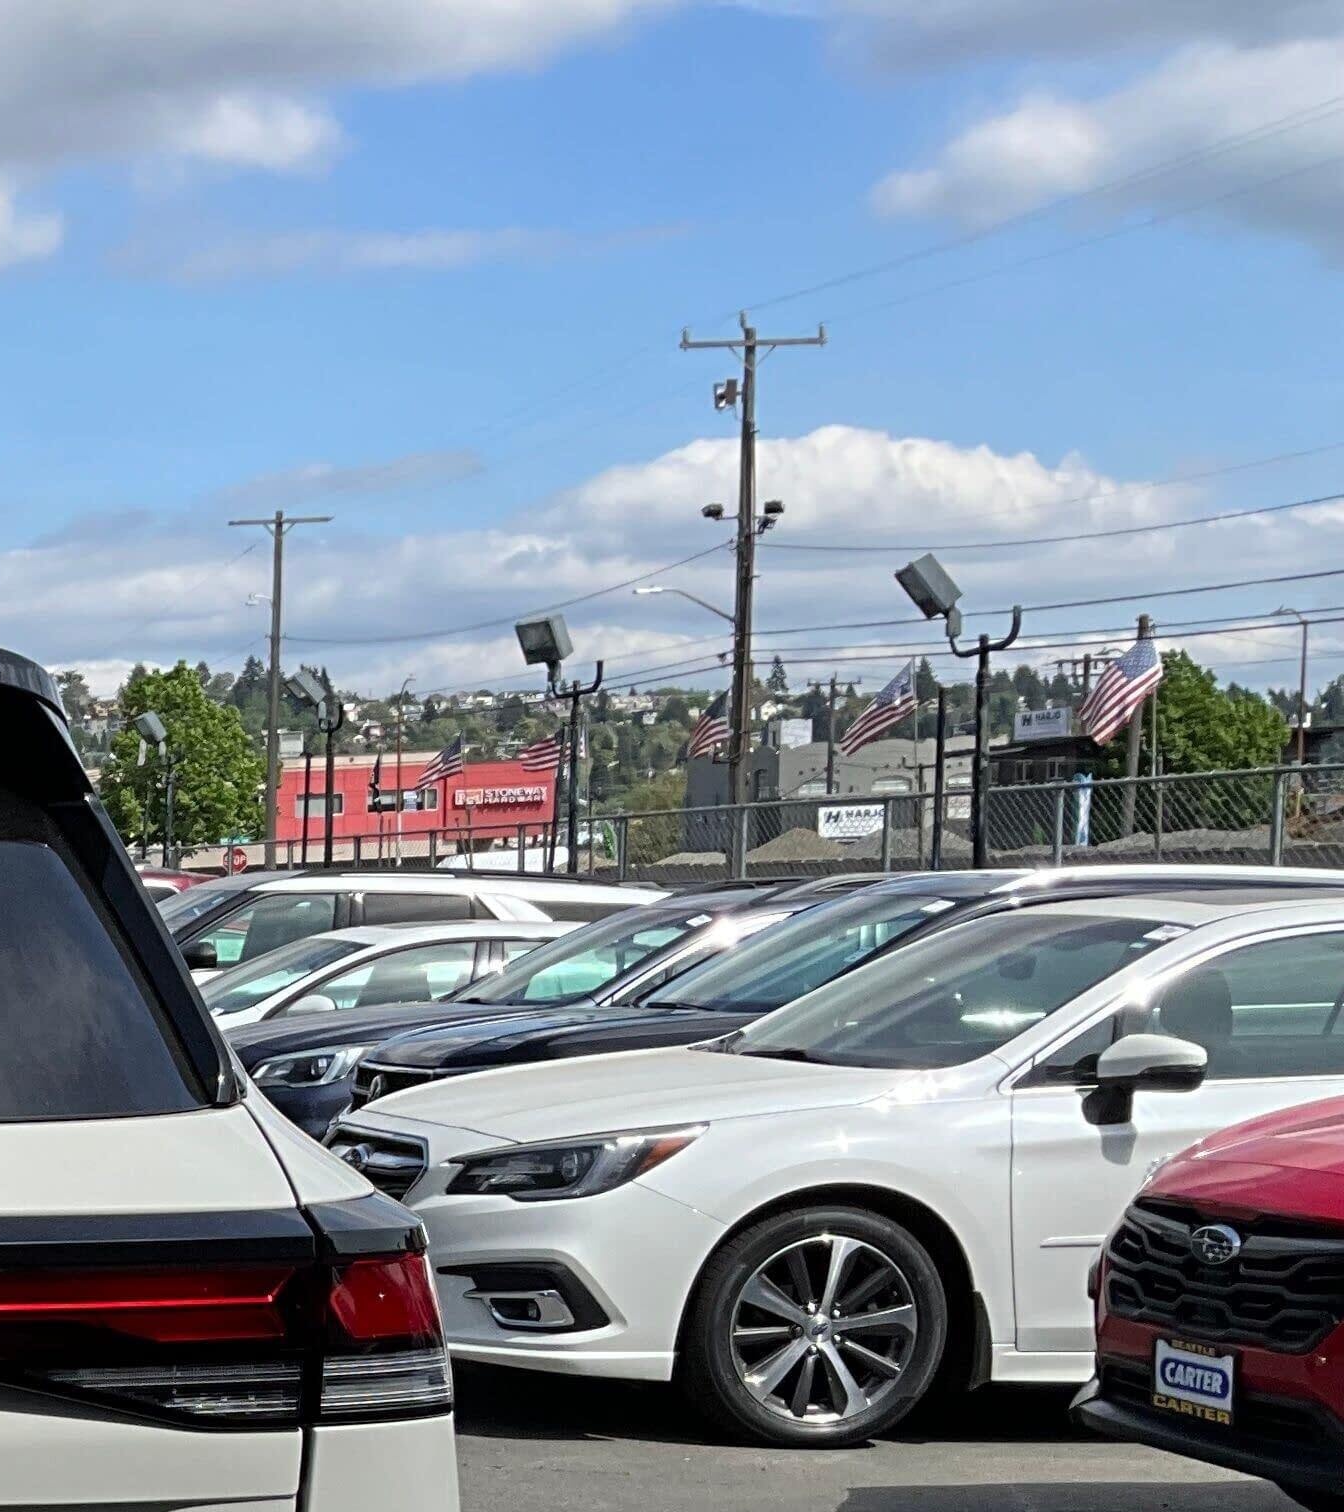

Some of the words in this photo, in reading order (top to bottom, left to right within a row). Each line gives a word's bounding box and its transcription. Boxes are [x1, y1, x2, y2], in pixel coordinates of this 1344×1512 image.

[484, 787, 548, 798] STONEWAY
[484, 794, 548, 804] HARDWARE
[1172, 1340, 1216, 1356] SEATTLE
[1165, 1361, 1223, 1394] CARTER
[1153, 1394, 1230, 1425] CARTER
